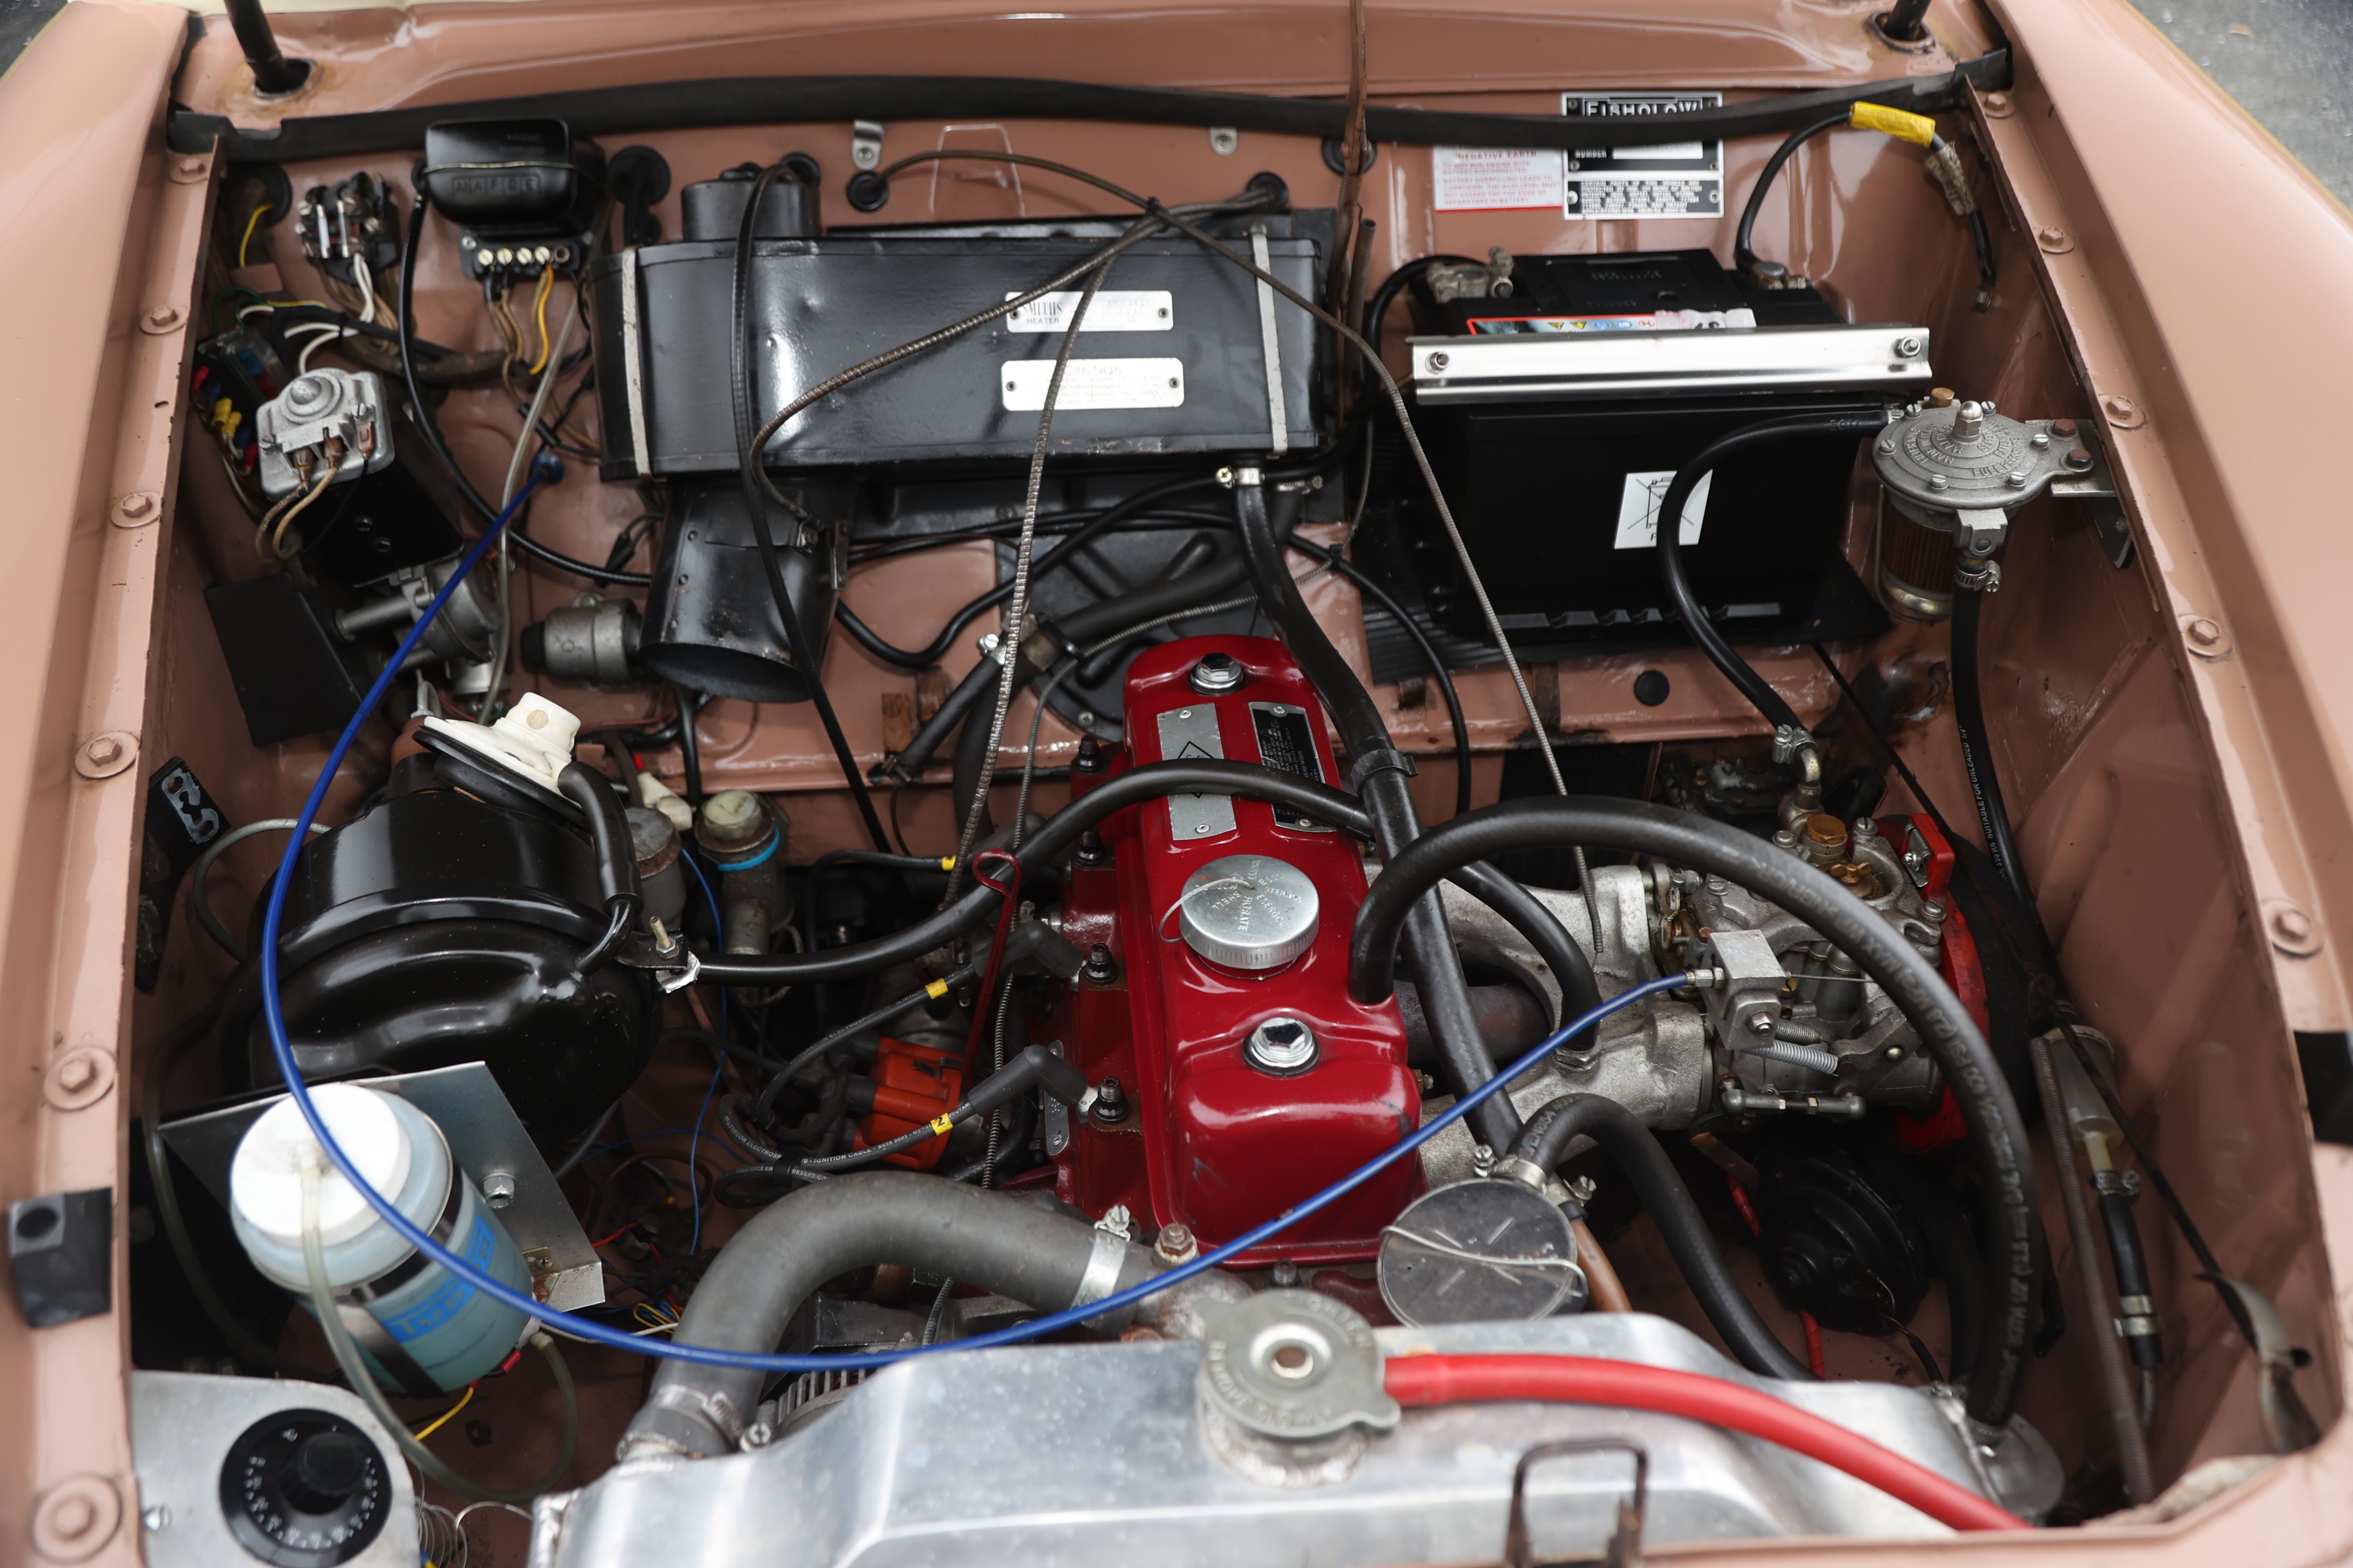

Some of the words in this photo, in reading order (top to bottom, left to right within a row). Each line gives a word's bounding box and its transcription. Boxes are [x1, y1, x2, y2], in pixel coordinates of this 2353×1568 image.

[1458, 151, 1503, 160] NEGATIVE
[1507, 150, 1538, 158] EARTH
[1022, 301, 1063, 316] SMITHS
[1064, 365, 1123, 376] CAUTION
[1927, 448, 1955, 465] MADE
[1972, 465, 2002, 478] FUEL
[2000, 437, 2022, 470] PRESSURE
[1297, 750, 1306, 765] PATENTS
[1962, 742, 1978, 782] UNLEADED
[1972, 783, 1983, 800] FOR
[1977, 800, 1994, 839] SUITABLE
[1211, 891, 1242, 910] SHELL
[1237, 895, 1254, 931] FILTRATE
[1255, 894, 1285, 927] ENERGOL
[1860, 933, 1901, 977] MAX
[1944, 1036, 1974, 1069] PSI
[722, 1115, 747, 1144] MAGNECOR
[745, 1139, 782, 1161] ELECTROSP
[813, 1153, 846, 1163] IGNITION
[848, 1147, 872, 1158] CABLE
[912, 1122, 932, 1136] METAL
[946, 1101, 971, 1118] DUCTAN
[933, 1115, 945, 1127] 2
[791, 1168, 815, 1179] RESSED
[387, 1232, 492, 1336] TUDR
